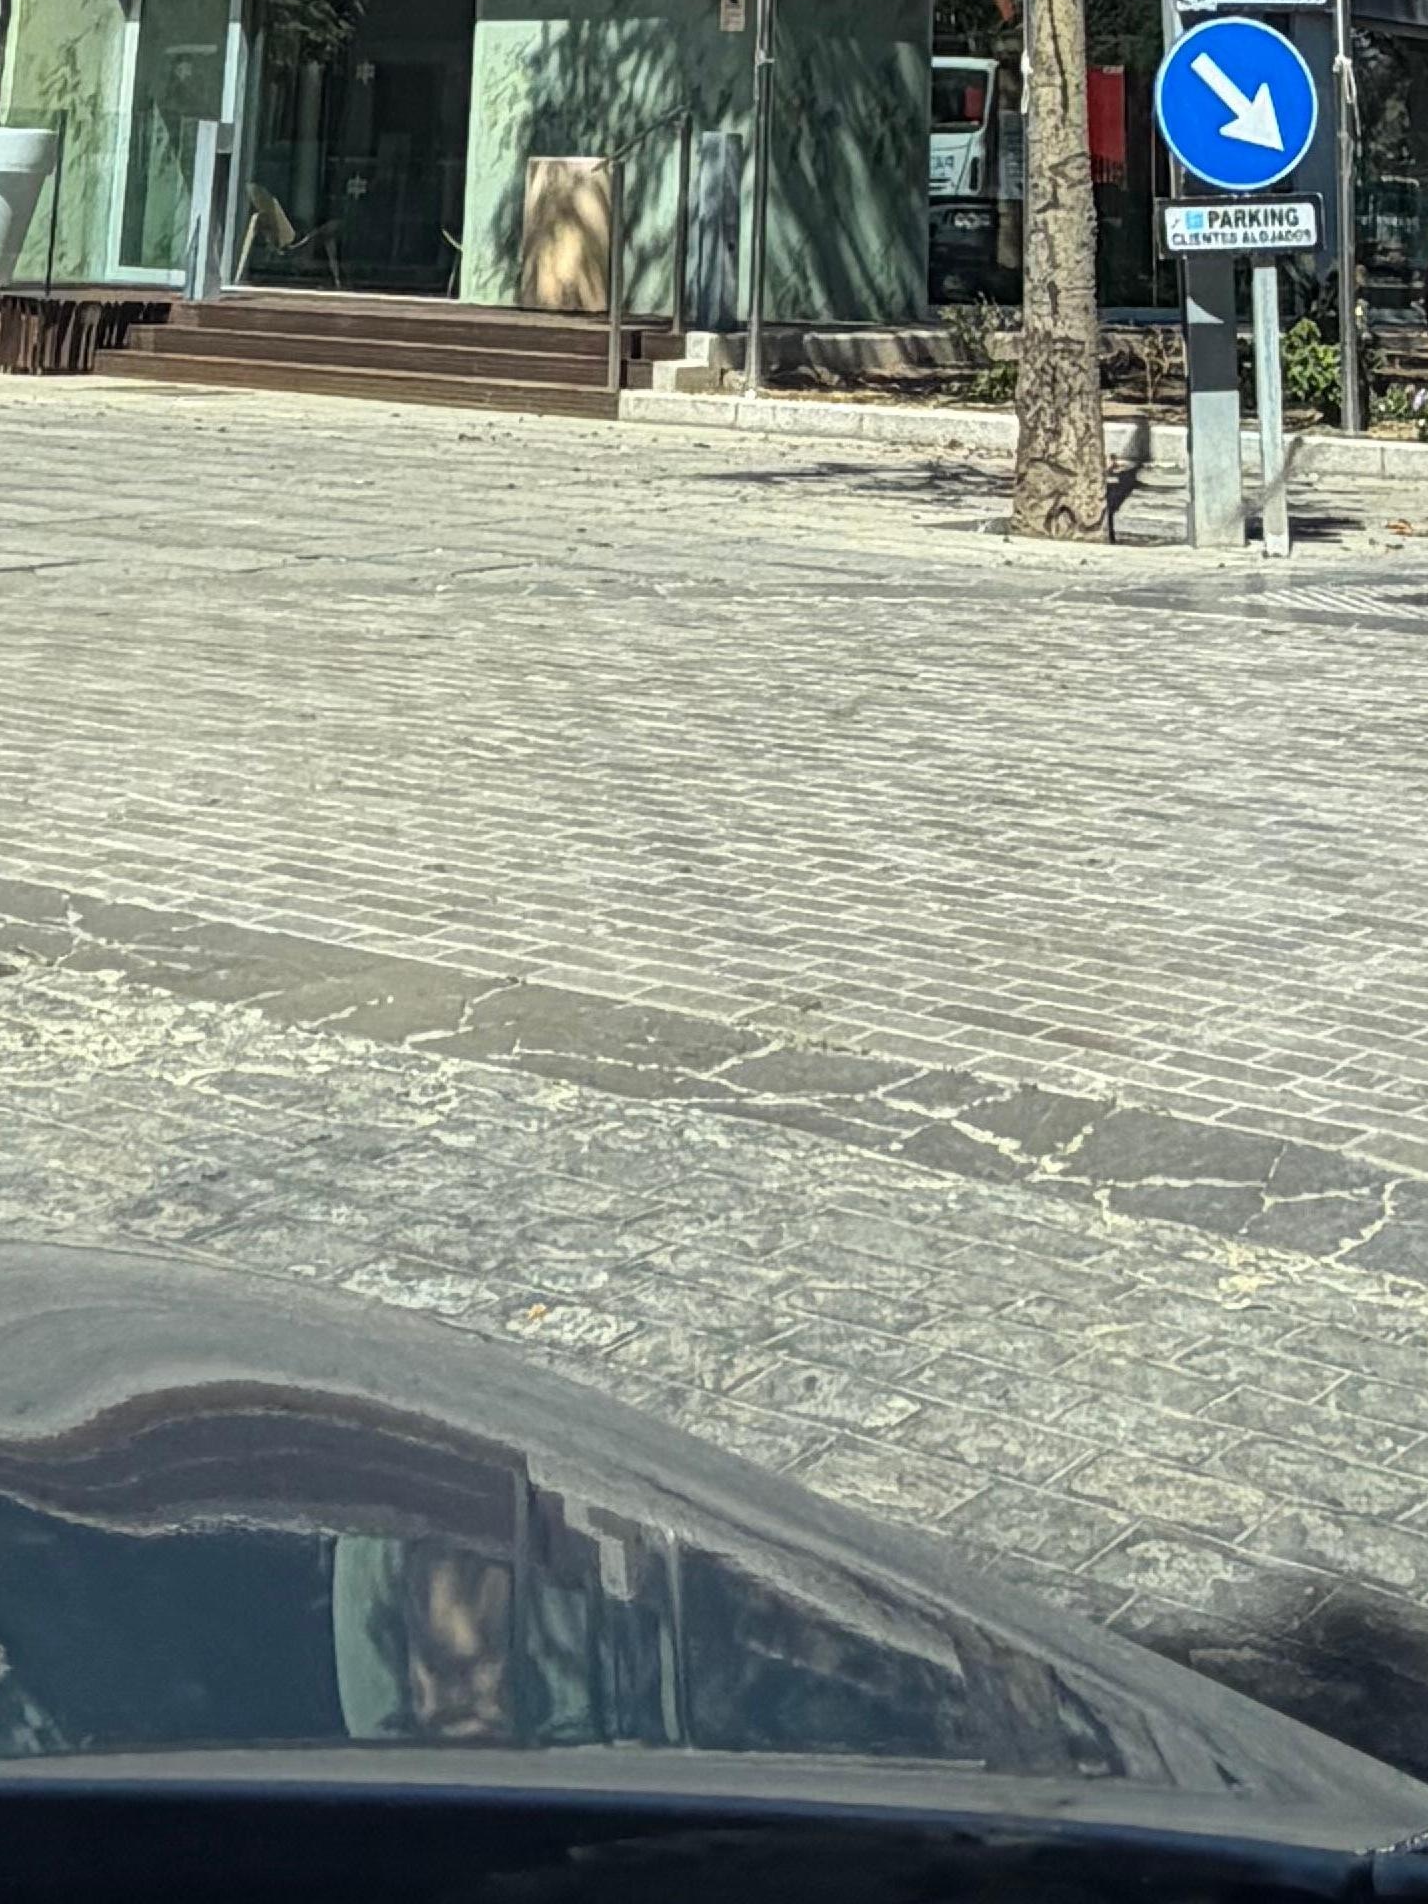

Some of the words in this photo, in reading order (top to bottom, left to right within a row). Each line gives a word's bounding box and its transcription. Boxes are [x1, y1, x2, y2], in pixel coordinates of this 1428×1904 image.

[1208, 206, 1300, 229] PARKING
[1172, 231, 1238, 245] CLIENTES
[1242, 229, 1312, 244] ALOJADOS
